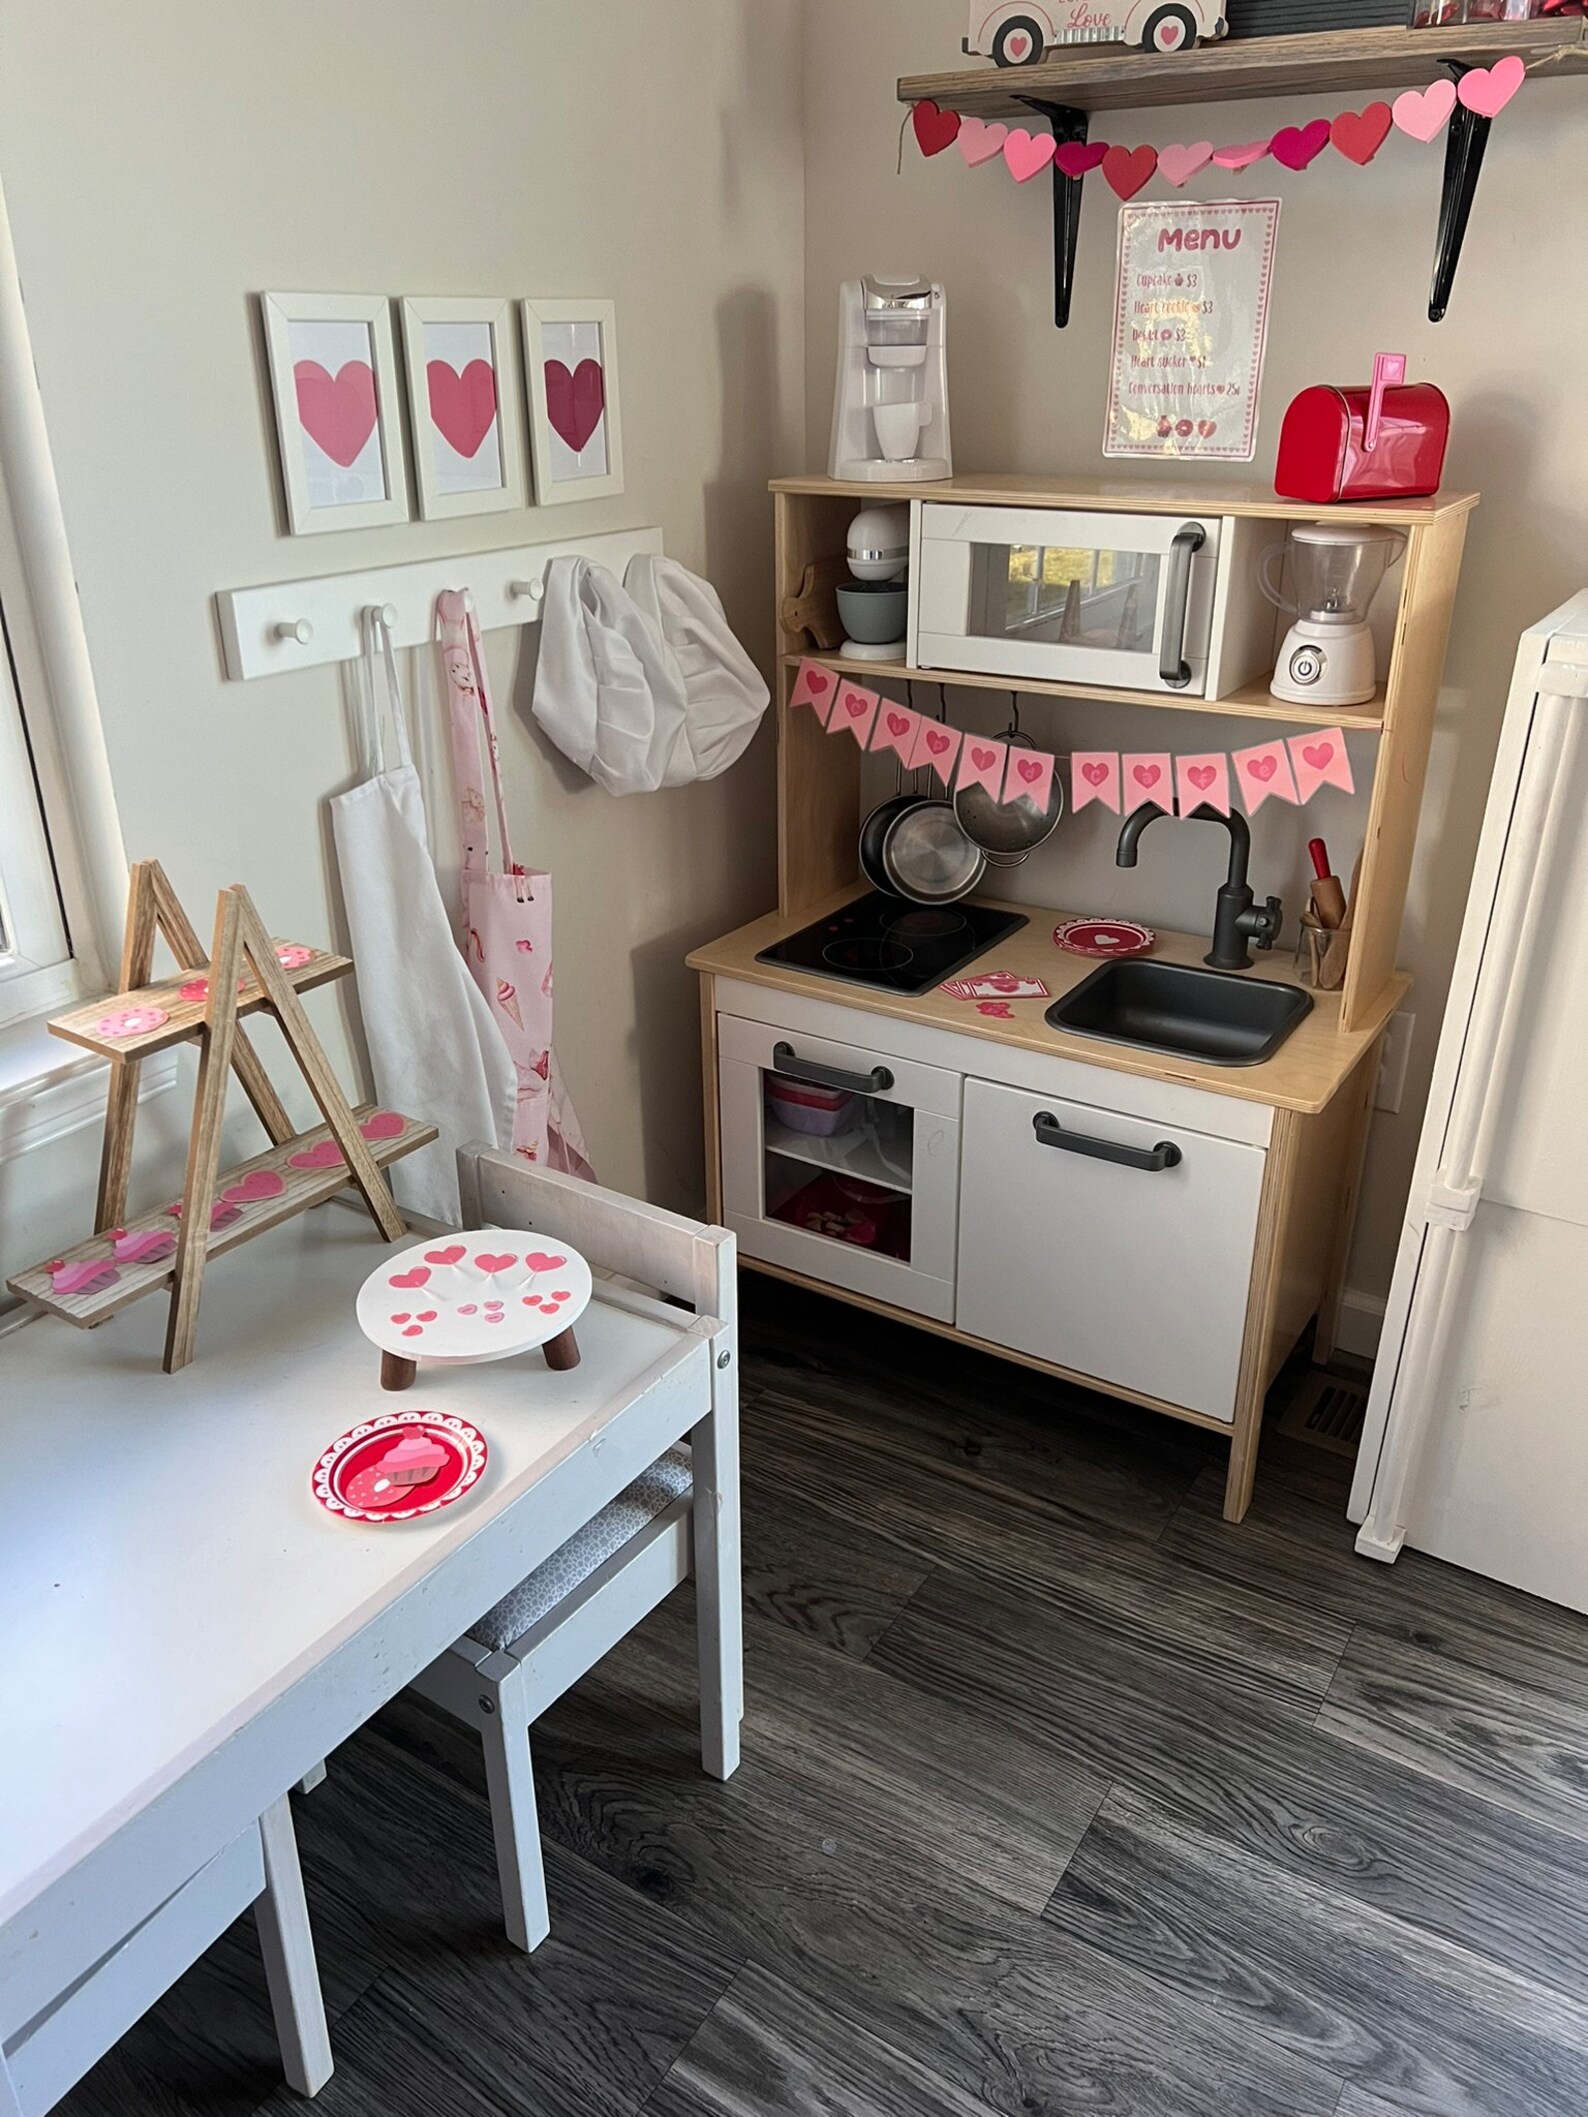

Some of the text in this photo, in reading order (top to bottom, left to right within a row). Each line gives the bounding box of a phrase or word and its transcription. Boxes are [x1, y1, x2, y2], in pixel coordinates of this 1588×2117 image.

[1136, 273, 1198, 288] Cupcake $3
[1134, 300, 1159, 315] Heart
[1201, 300, 1214, 315] $3
[1131, 354, 1155, 368] Heart
[1157, 354, 1187, 368] sucker
[1187, 382, 1216, 396] hearts
